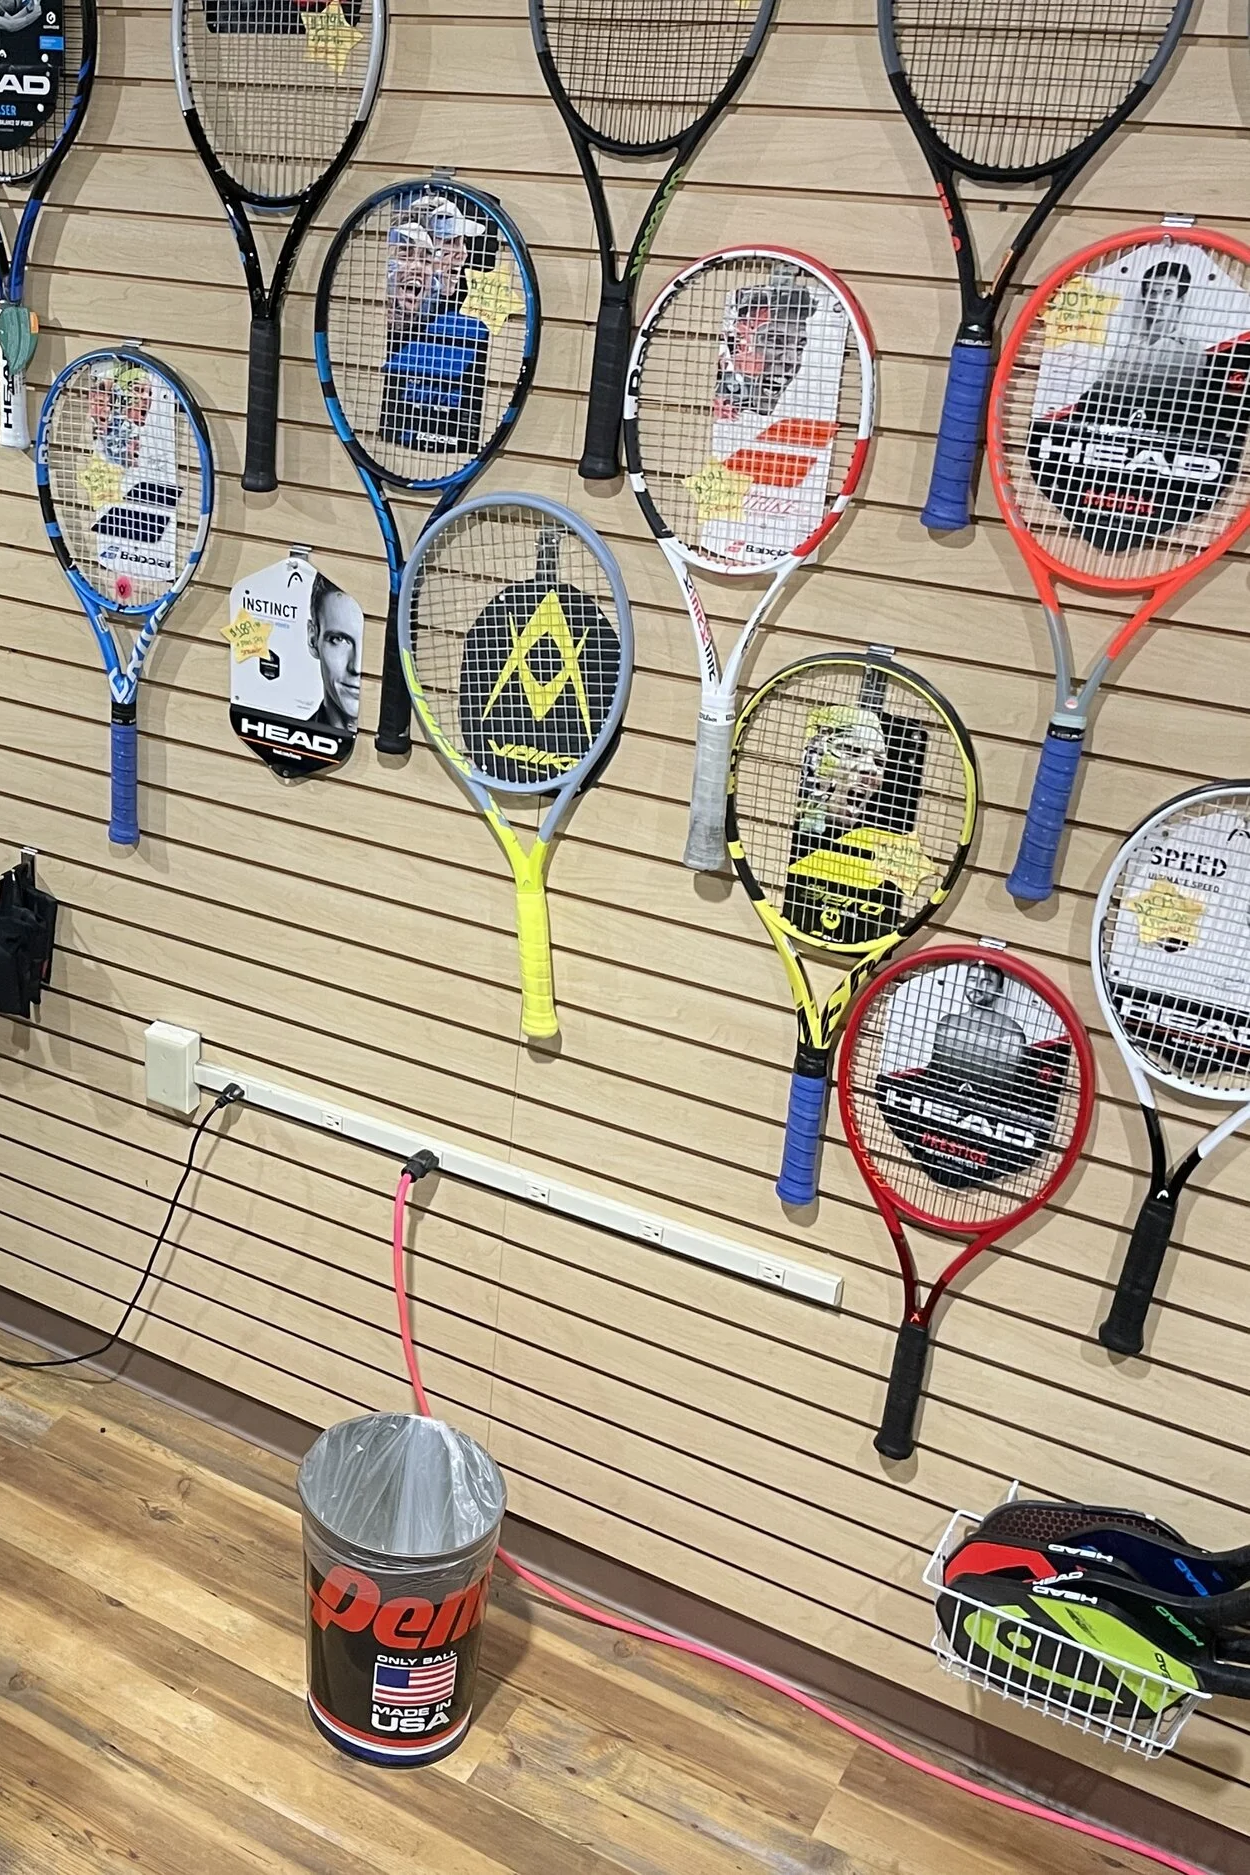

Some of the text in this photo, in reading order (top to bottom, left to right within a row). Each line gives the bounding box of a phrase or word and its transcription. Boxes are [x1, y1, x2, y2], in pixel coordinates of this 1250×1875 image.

[1038, 437, 1223, 482] HEAD
[242, 596, 298, 619] INSTINCT
[241, 718, 339, 754] HEAD
[1150, 846, 1227, 878] SPEED
[1190, 881, 1220, 894] SPEED
[885, 1089, 1036, 1150] HEAD
[922, 1132, 988, 1165] PRESTIGE
[1048, 1543, 1114, 1563] HEAD
[1032, 1571, 1084, 1586] HEAD
[1032, 1586, 1098, 1605] HEAD
[1155, 1605, 1205, 1647] HEAD
[376, 1650, 458, 1667] ONLY BALL
[372, 1698, 452, 1717] MADE IN
[371, 1711, 451, 1734] USA
